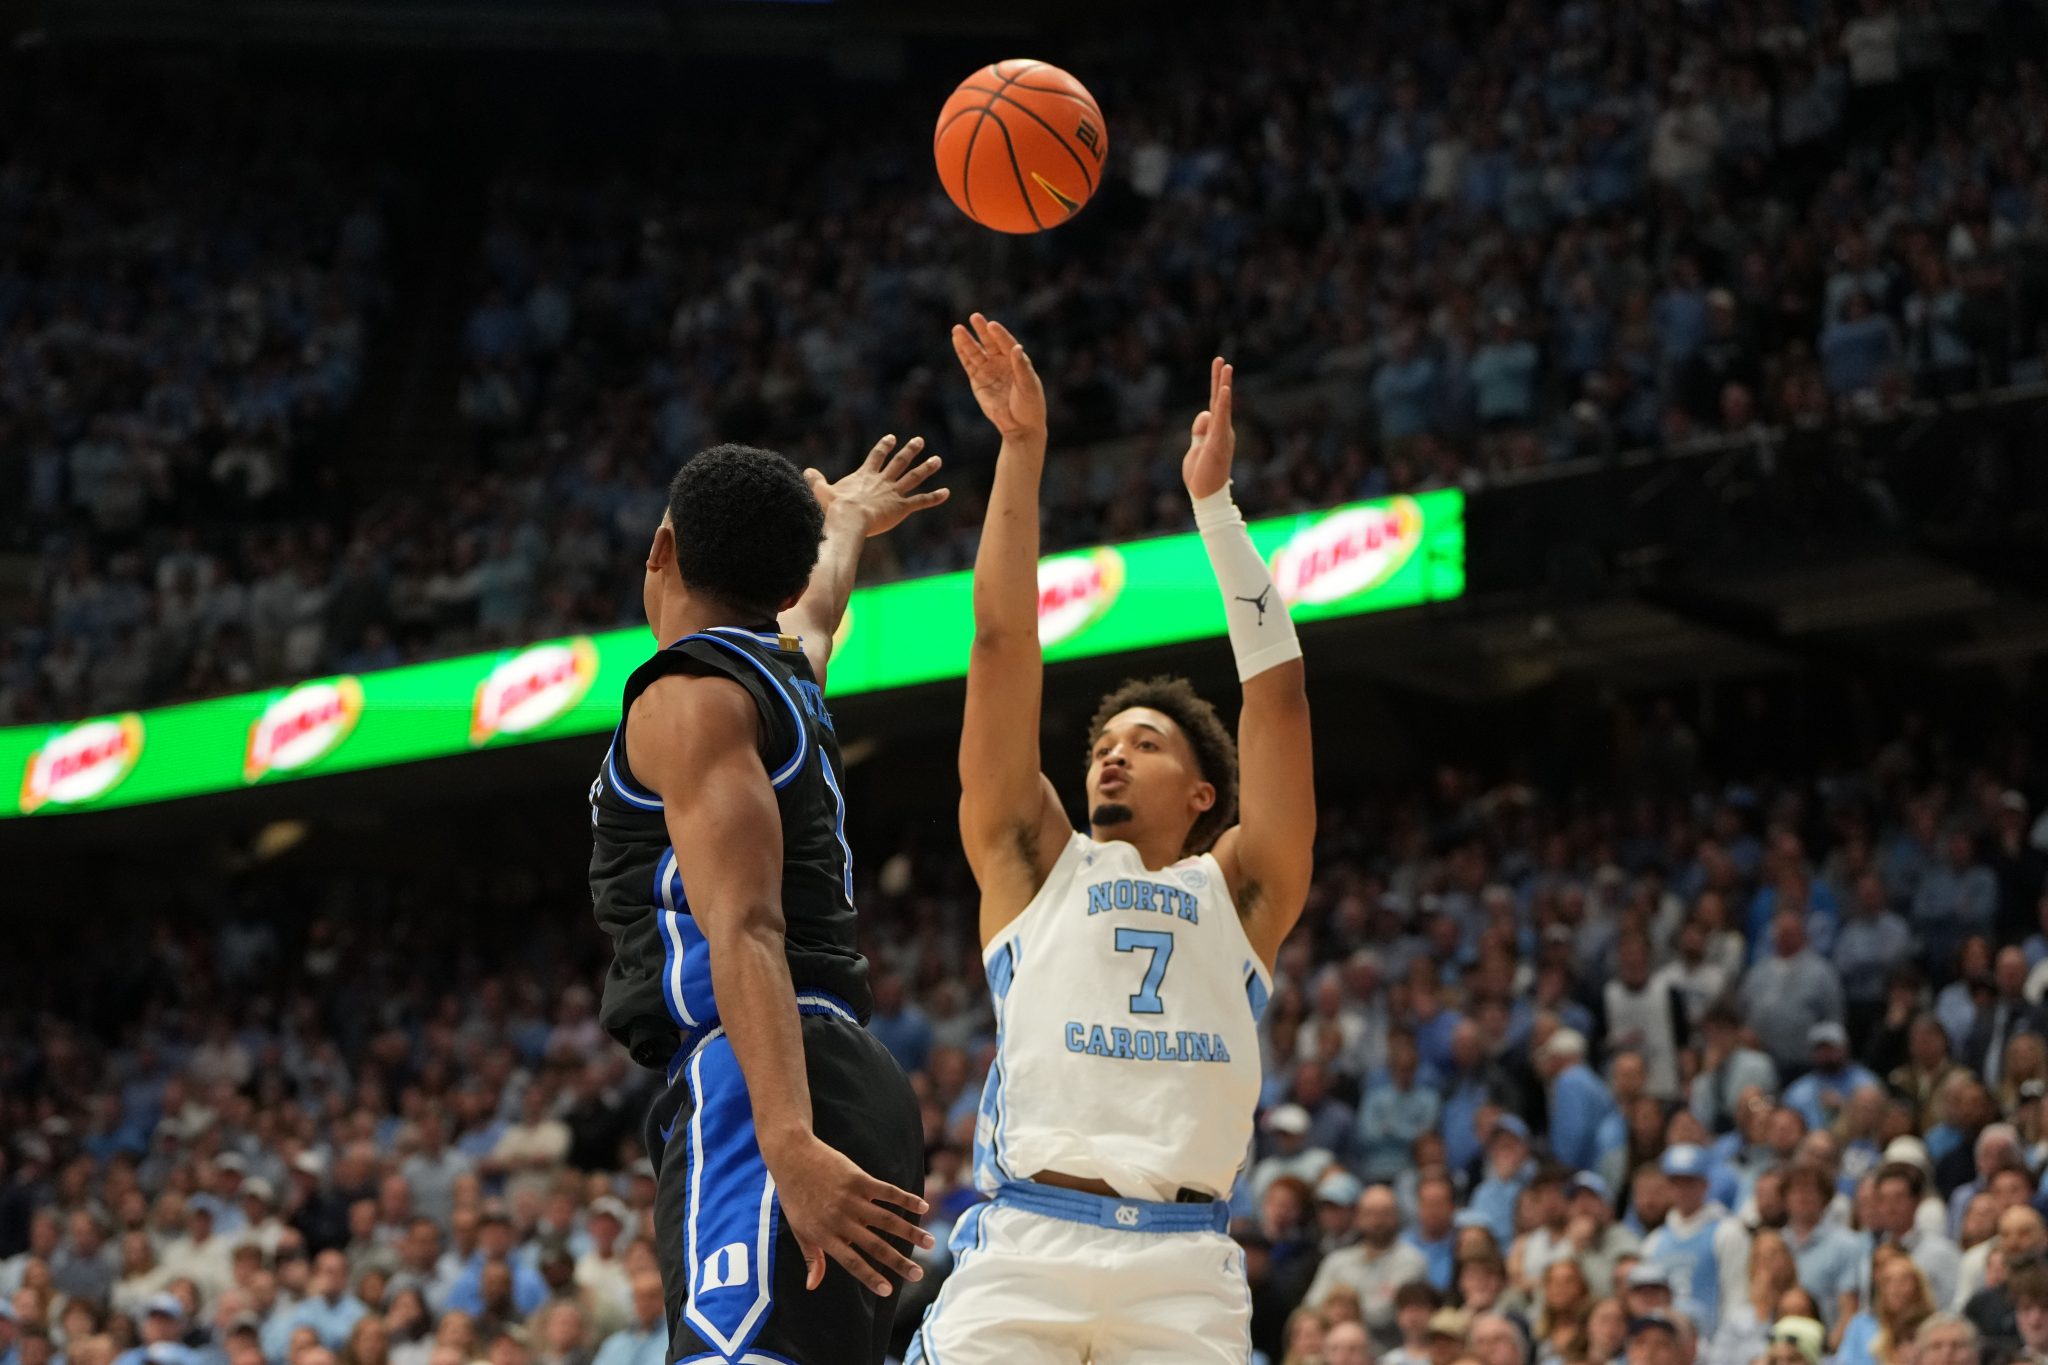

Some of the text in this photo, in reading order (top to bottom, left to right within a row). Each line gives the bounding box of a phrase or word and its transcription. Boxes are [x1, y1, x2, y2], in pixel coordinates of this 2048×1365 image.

[1087, 879, 1199, 925] NORTH
[1114, 927, 1174, 1014] 7
[1065, 1021, 1231, 1063] CAROLINA
[697, 1242, 749, 1295] D
